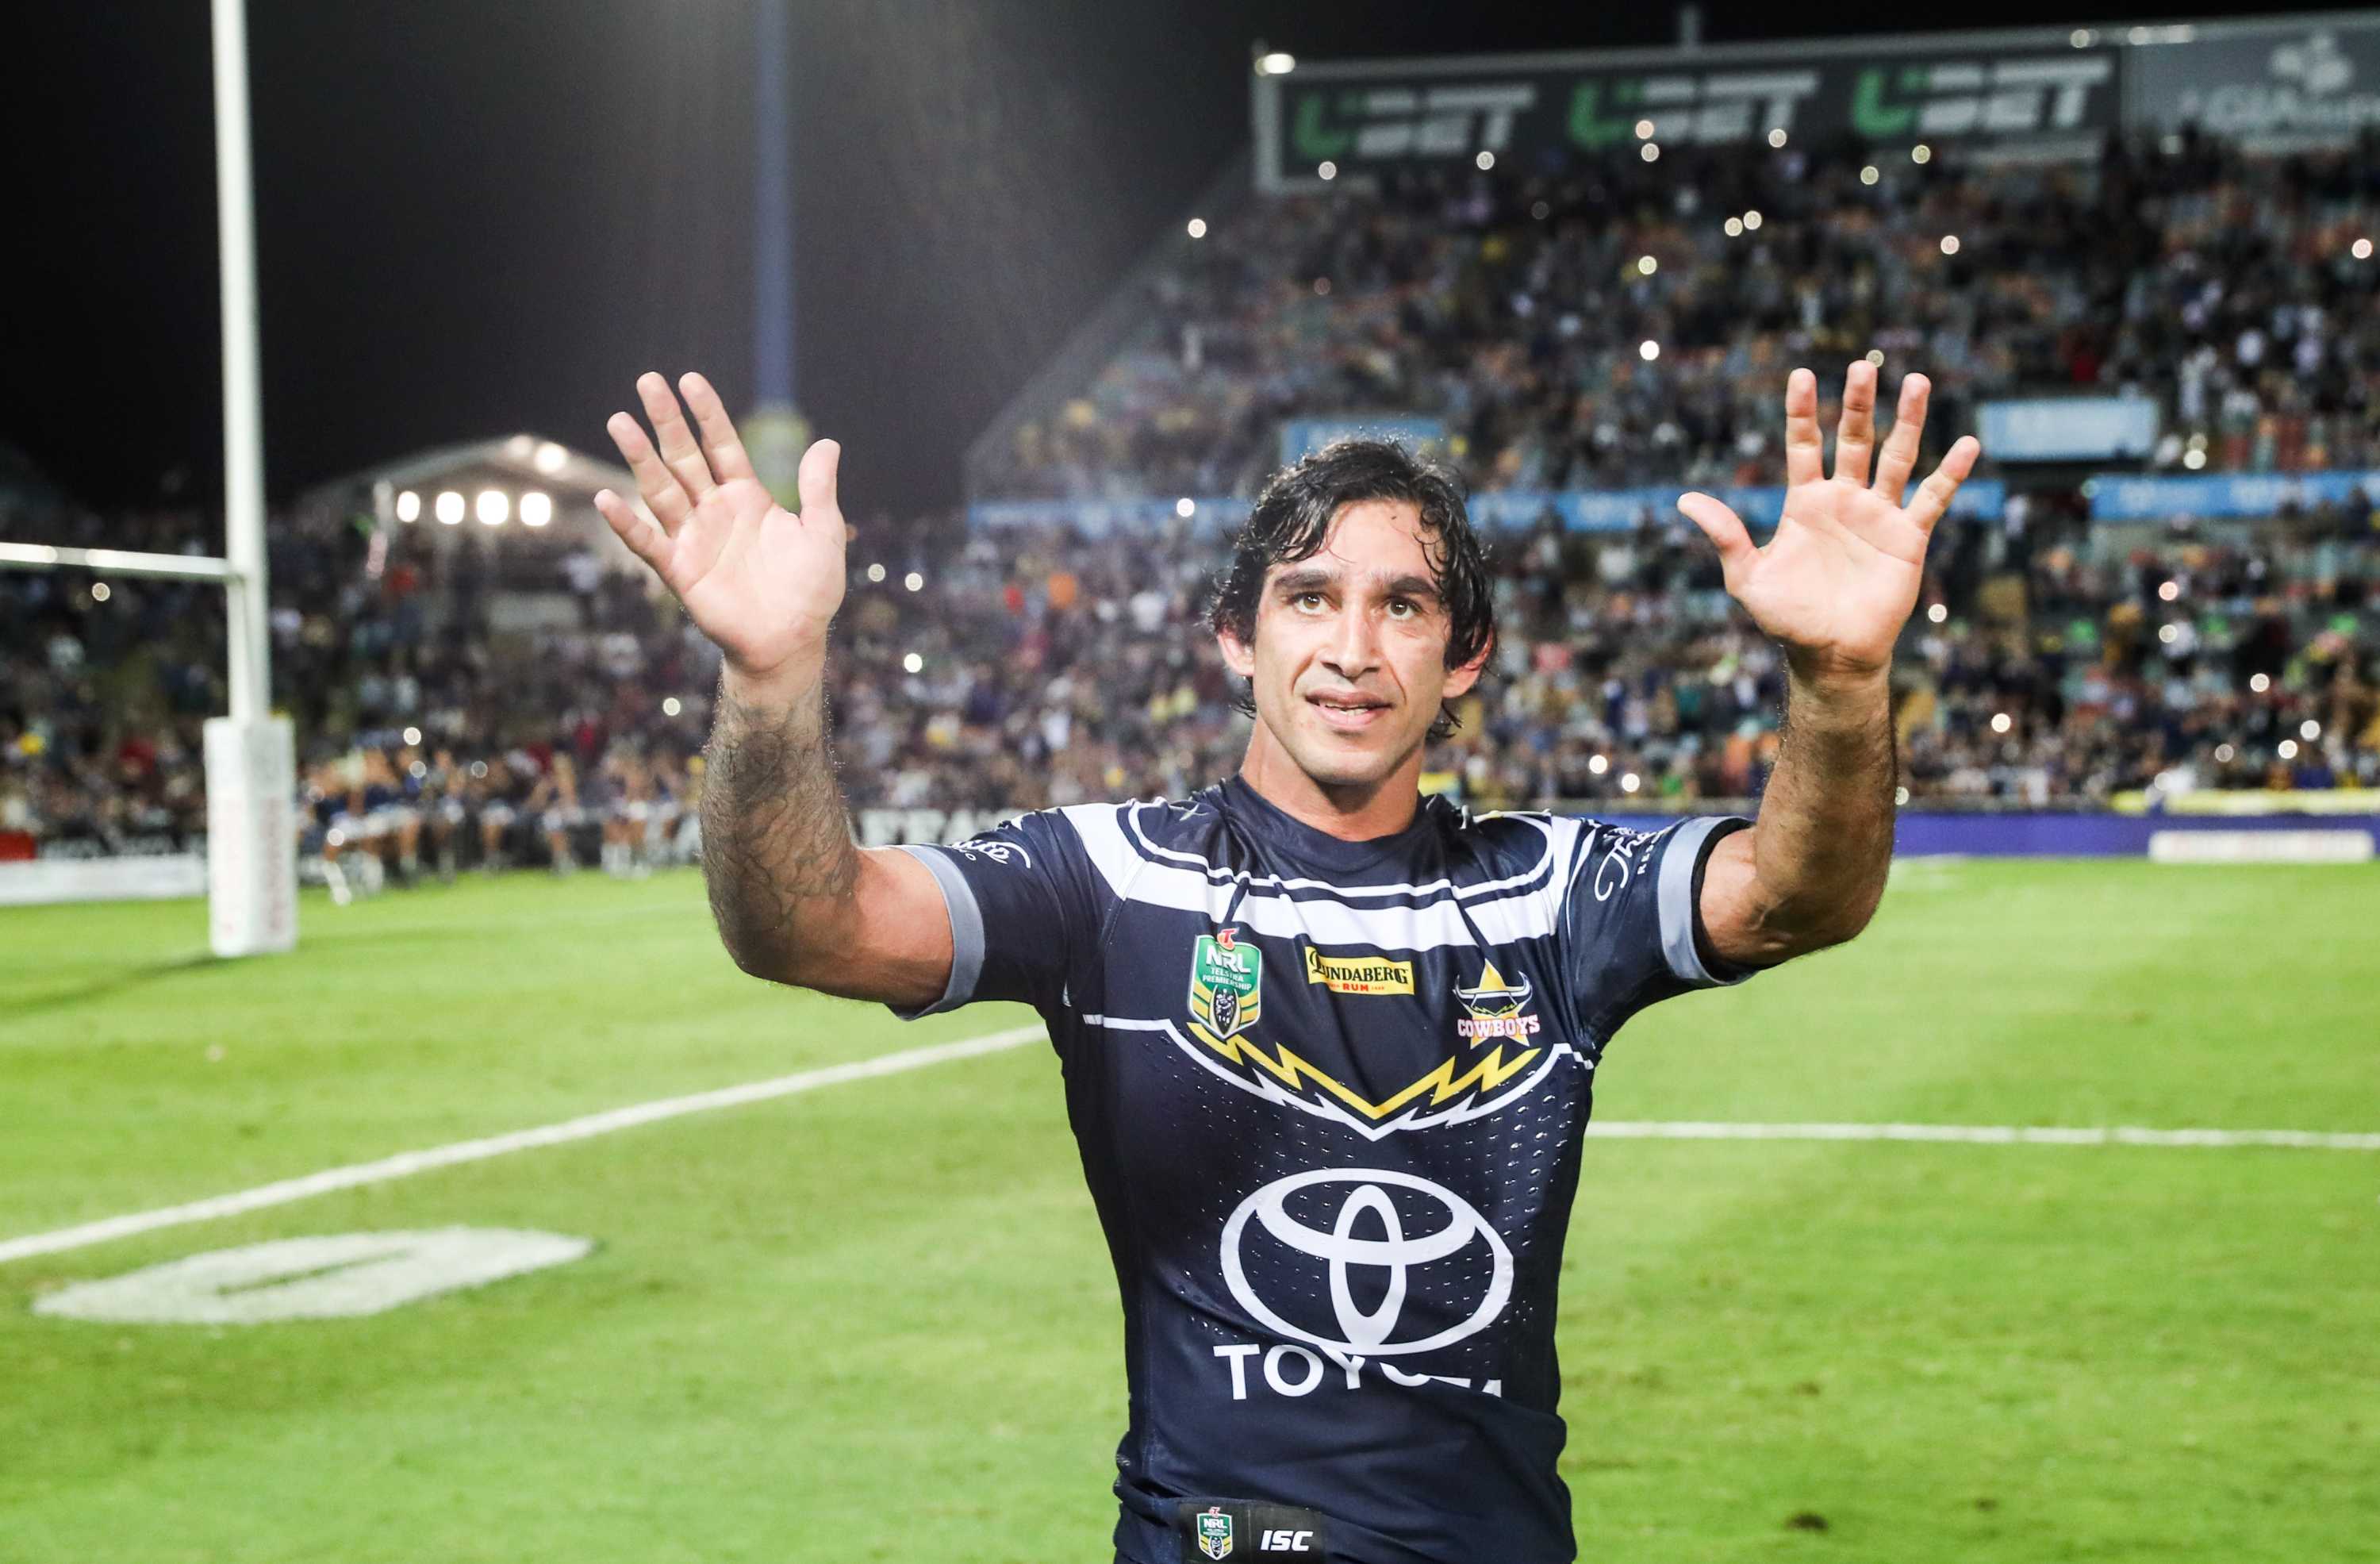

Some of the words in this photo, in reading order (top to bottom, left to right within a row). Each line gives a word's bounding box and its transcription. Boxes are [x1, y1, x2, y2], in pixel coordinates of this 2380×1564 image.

[1206, 944, 1251, 974] NRL
[1211, 967, 1245, 982] TELSTRA
[1457, 1014, 1541, 1038] COWBOYS
[1203, 1518, 1227, 1529] NRL
[1261, 1530, 1314, 1551] ISC
